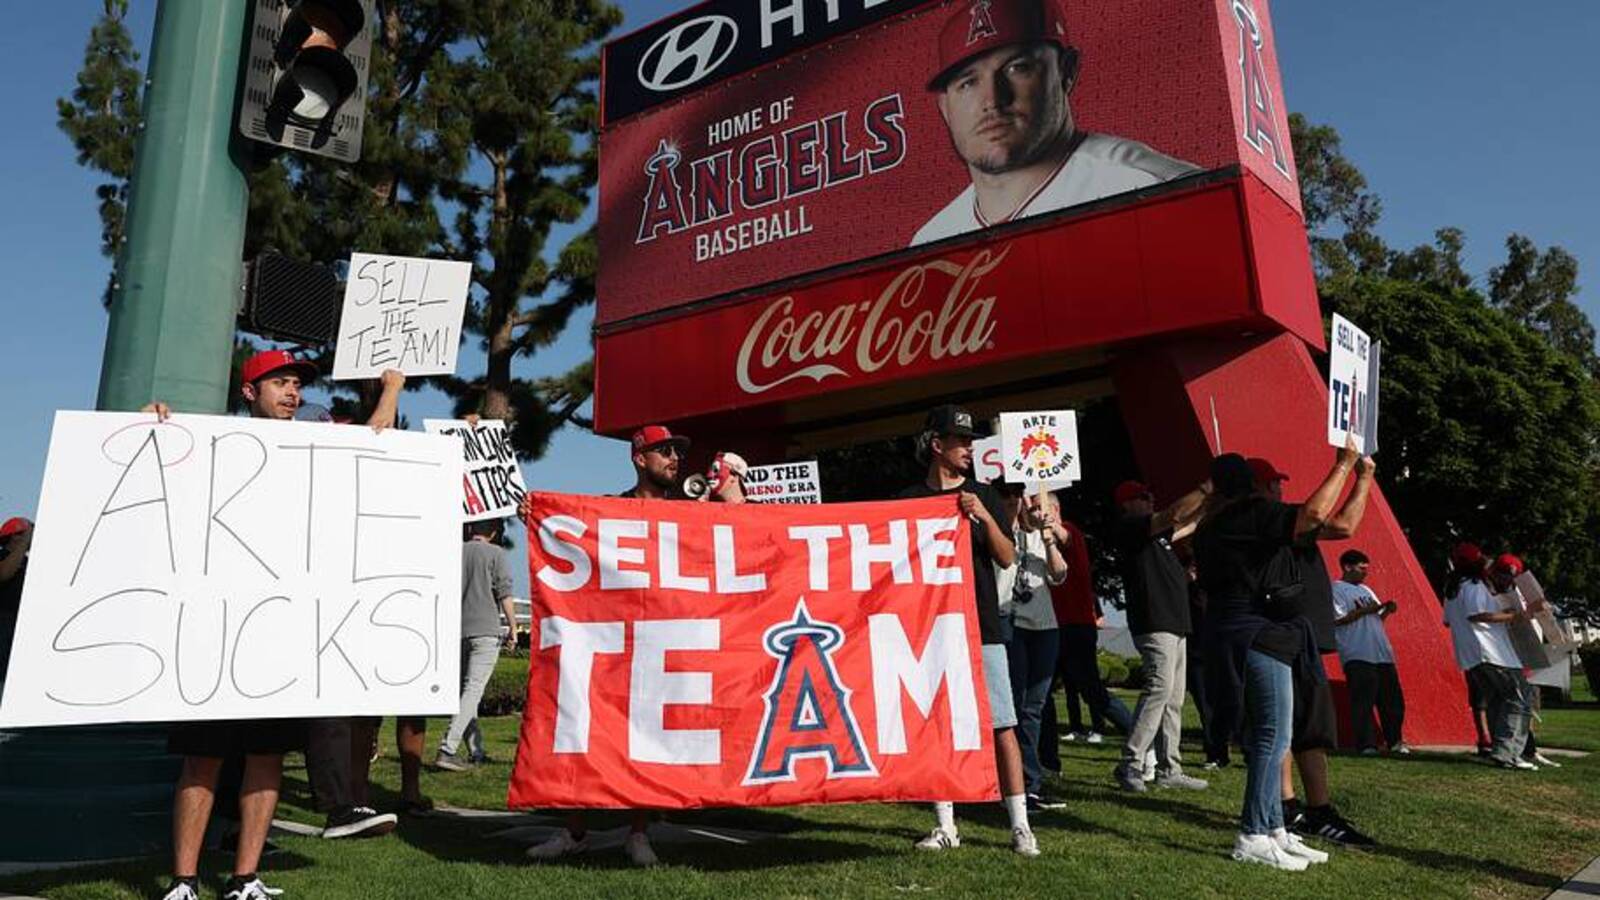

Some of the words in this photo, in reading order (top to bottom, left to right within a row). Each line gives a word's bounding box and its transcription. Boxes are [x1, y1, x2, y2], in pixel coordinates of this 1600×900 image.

[708, 107, 763, 146] HOME
[769, 96, 795, 125] OF
[635, 93, 906, 244] ANGELS
[695, 205, 814, 262] BASEBALL
[354, 259, 450, 307] SELL
[380, 308, 420, 336] THE
[736, 243, 1012, 393] Coca-Cola
[1336, 322, 1354, 353] SELL
[347, 325, 450, 369] TEAM!
[1022, 415, 1057, 429] ARTE
[462, 464, 528, 515] ATTERS
[744, 468, 769, 484] ND
[772, 464, 810, 481] THE
[788, 481, 817, 494] ERA
[1038, 452, 1074, 479] CLOWN
[71, 423, 442, 587] ARTE
[535, 514, 767, 594] SELL
[788, 516, 963, 592] THE
[45, 588, 440, 706] SUCKS!
[539, 595, 982, 787] TEAM
